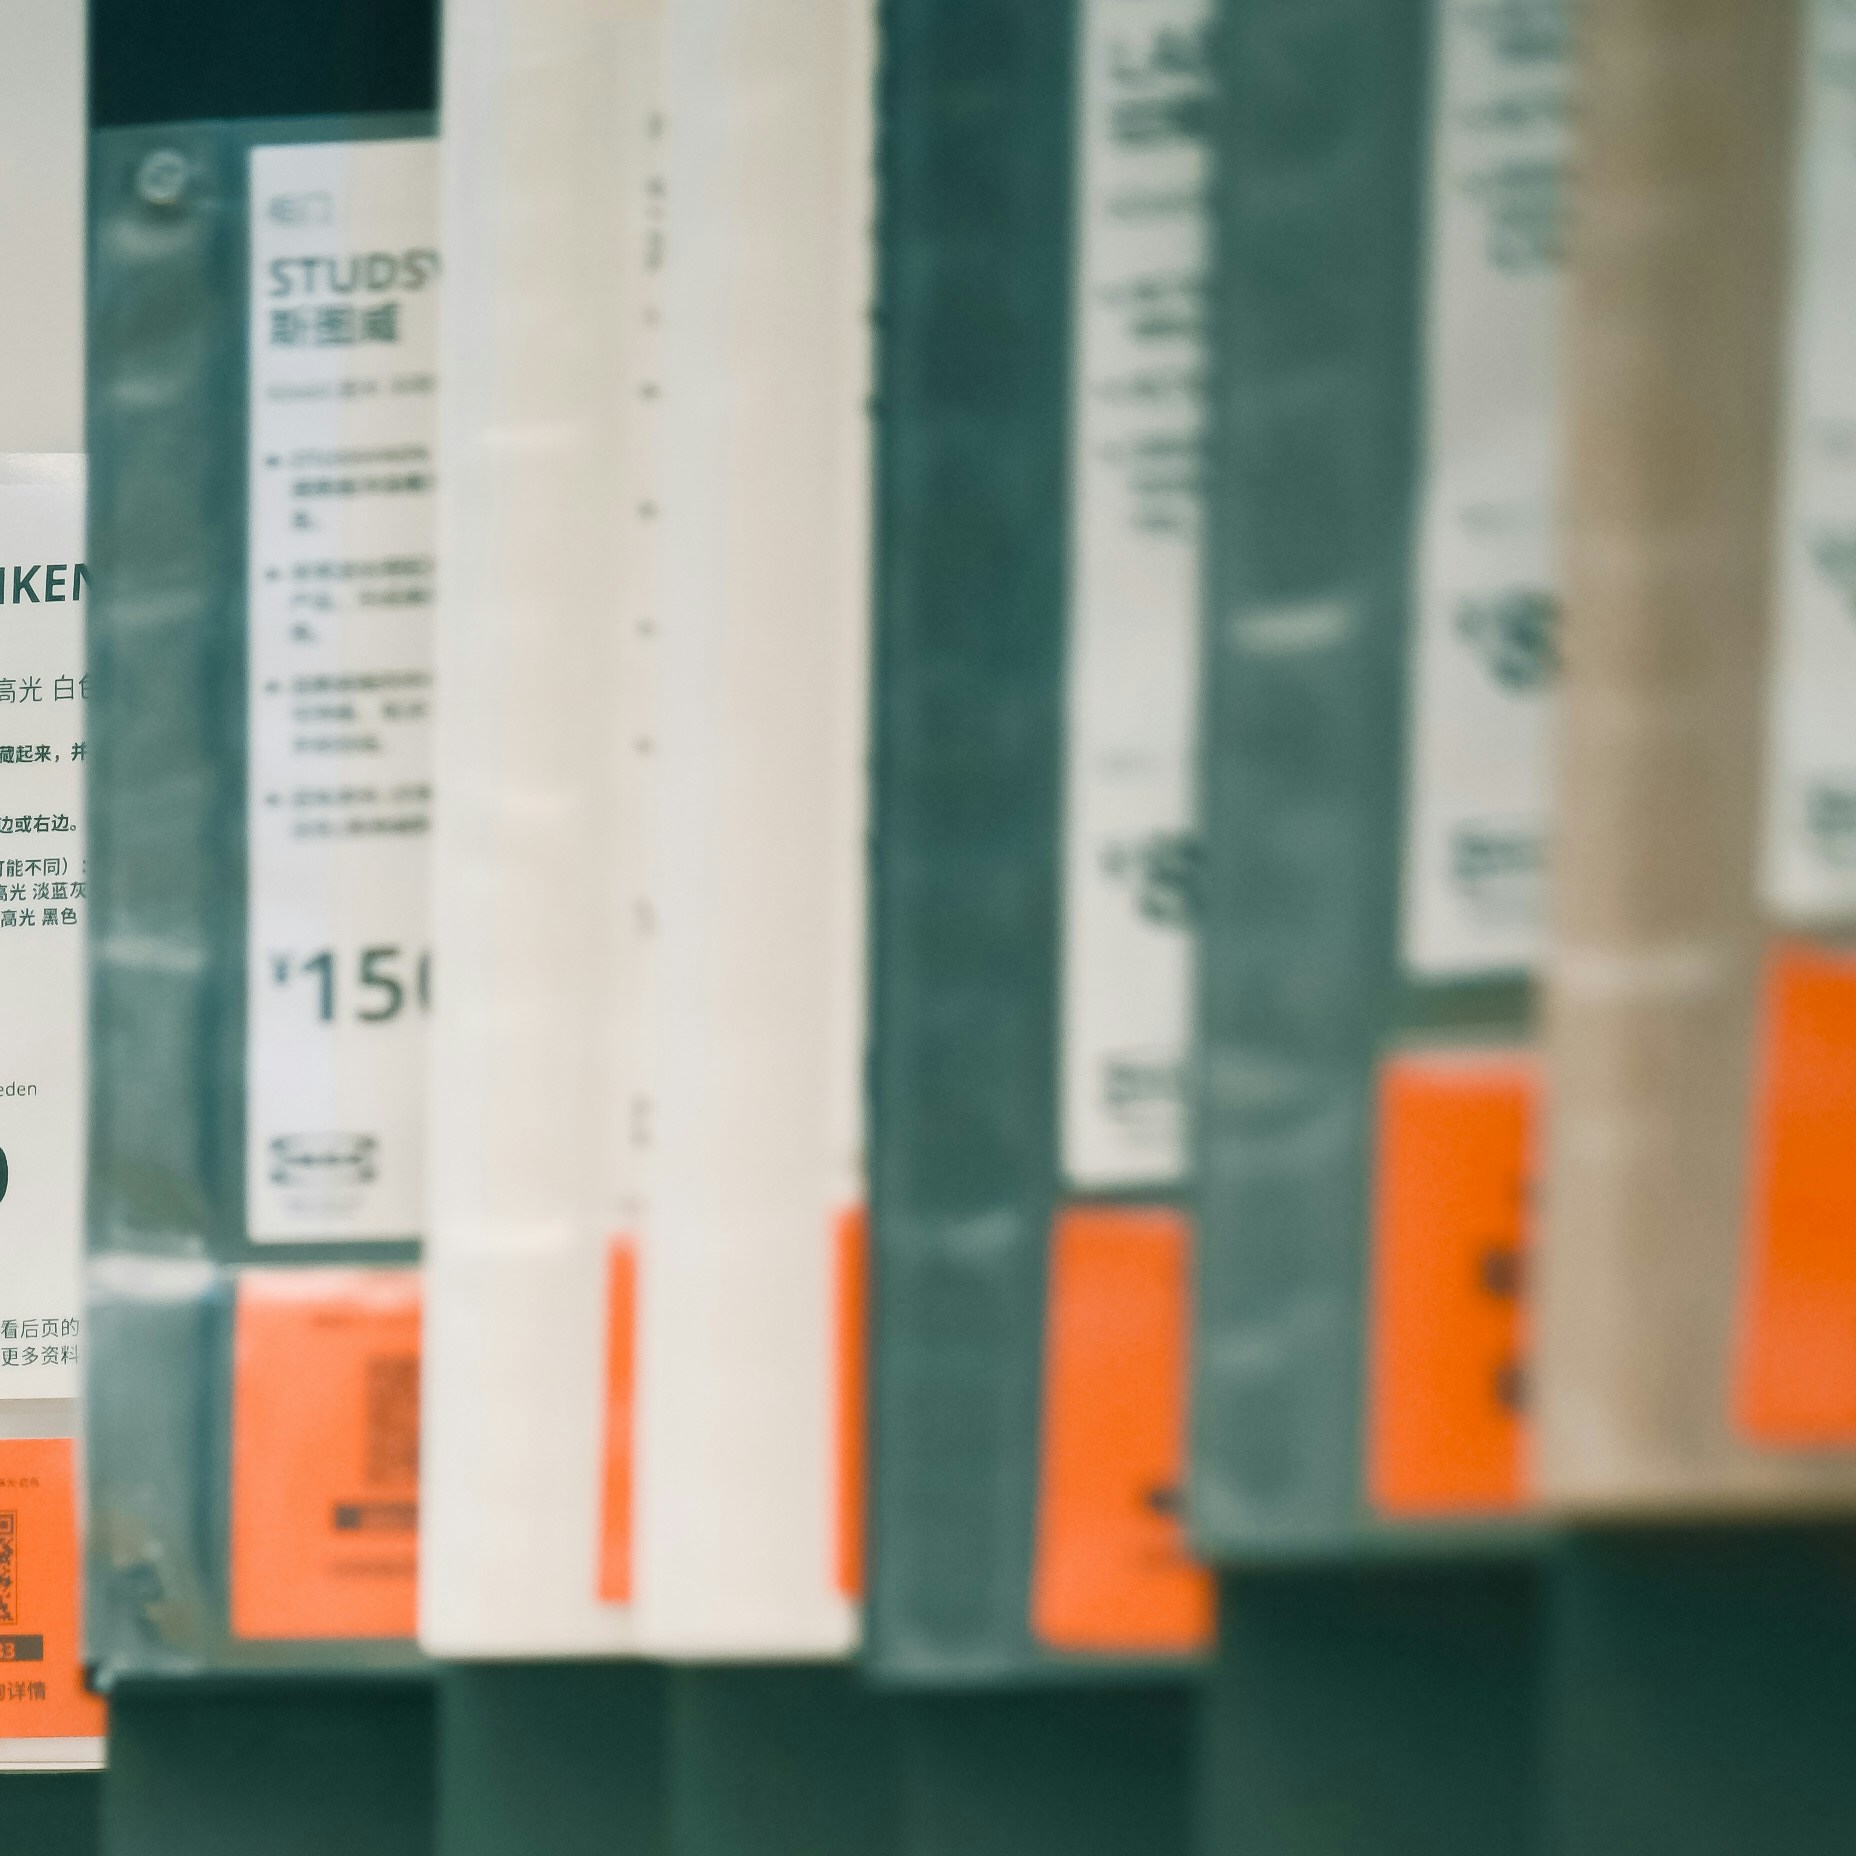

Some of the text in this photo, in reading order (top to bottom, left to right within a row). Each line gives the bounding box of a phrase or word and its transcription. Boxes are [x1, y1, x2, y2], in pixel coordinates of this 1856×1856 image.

[33, 881, 87, 900] 淡蓝灰
[1, 908, 35, 928] 高光
[42, 907, 78, 926] 黑色
[1, 1345, 79, 1366] 更多资料
